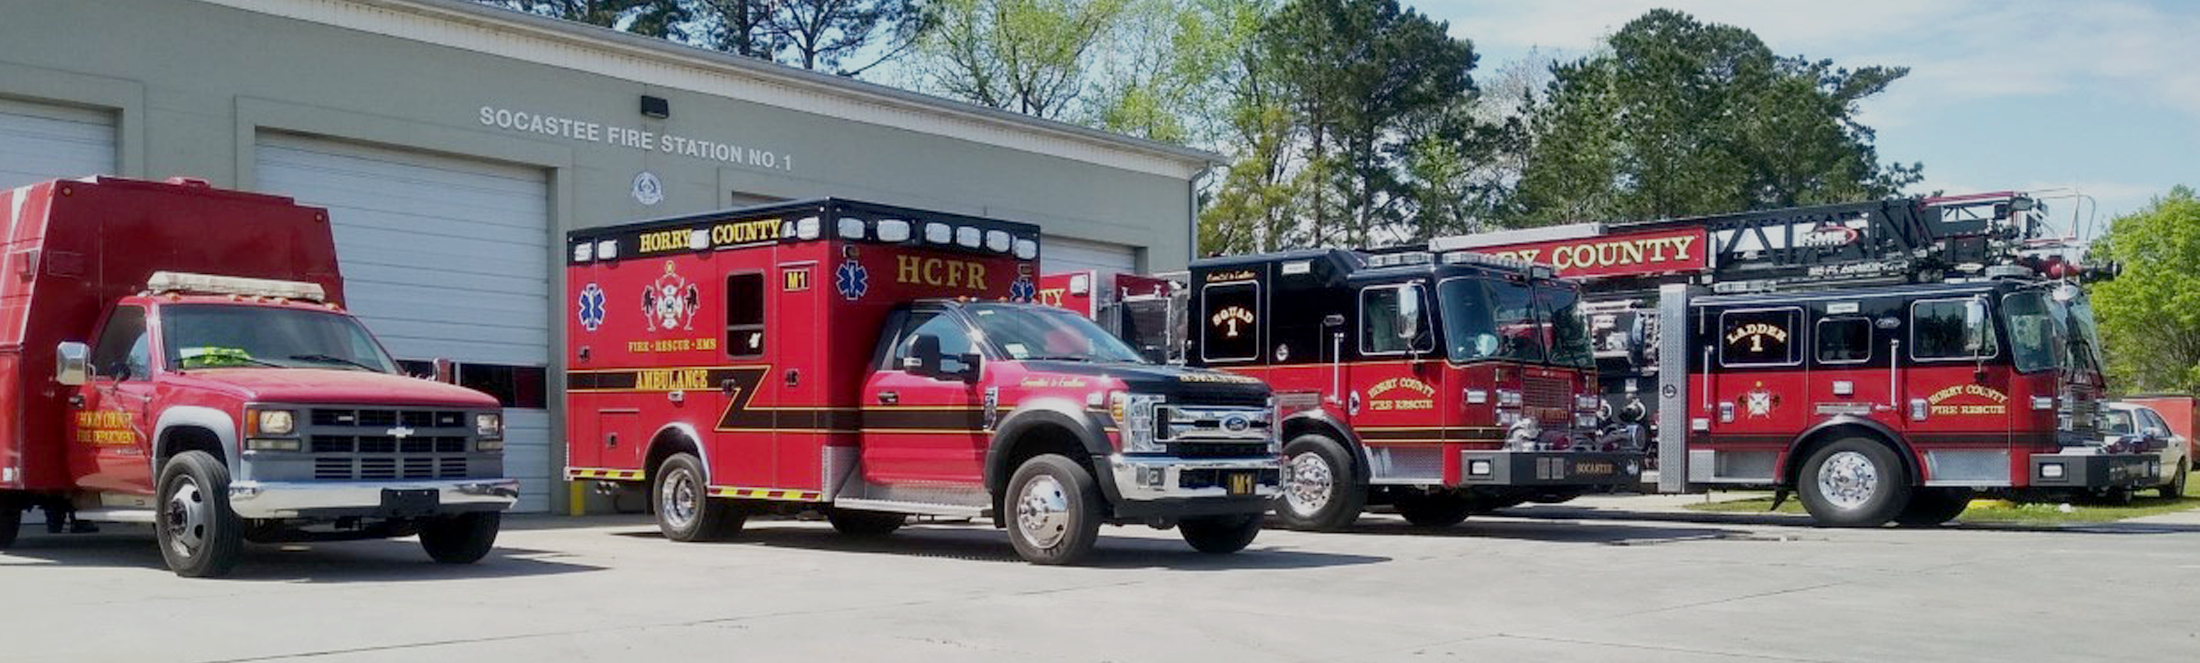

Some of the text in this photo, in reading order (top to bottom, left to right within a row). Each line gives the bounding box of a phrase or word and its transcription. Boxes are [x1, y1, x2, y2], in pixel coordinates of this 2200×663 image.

[479, 105, 600, 142] SOCASTEE
[607, 126, 653, 150] FIRE
[661, 135, 743, 163] STATION
[639, 219, 782, 252] HORRY COUNTY
[1552, 235, 1696, 269] COUNTY
[787, 272, 808, 289] M1
[896, 255, 988, 290] HCFR
[1212, 306, 1254, 327] SQUAD
[1227, 318, 1238, 337] 1
[1726, 323, 1787, 345] LADDER
[628, 341, 649, 352] FIRE
[655, 339, 690, 352] RESCUE
[1750, 334, 1763, 352] 1
[635, 369, 708, 390] AMBULANCE
[1400, 377, 1435, 398] COUNTY
[1928, 384, 2008, 405] HORRY COUNTY
[1931, 405, 2006, 415] FIRE RESCUE
[1233, 473, 1252, 495] M1
